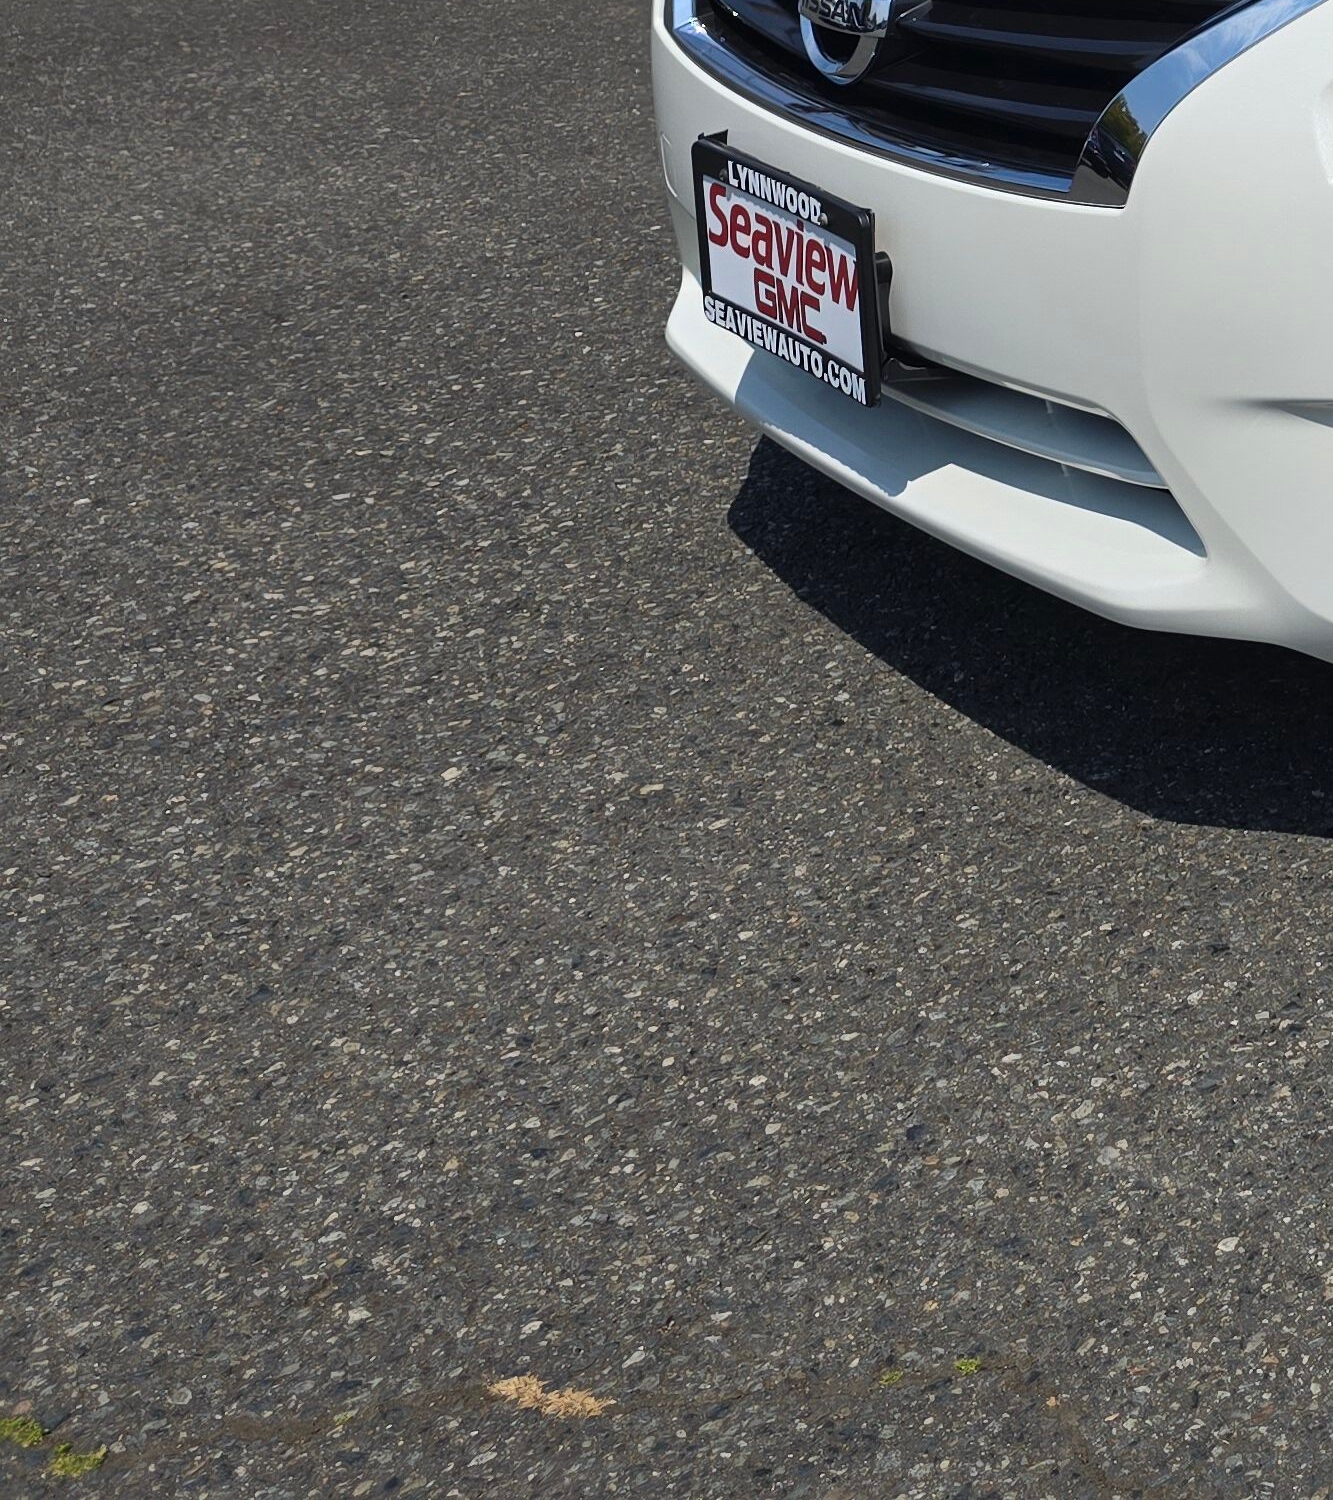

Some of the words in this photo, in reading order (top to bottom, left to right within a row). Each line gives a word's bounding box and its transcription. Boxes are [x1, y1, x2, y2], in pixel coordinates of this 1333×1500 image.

[727, 160, 823, 226] LYNNWOOD
[708, 182, 859, 312] Seaview
[704, 295, 868, 407] SEAVIEWAUTO.COM
[753, 267, 828, 346] GMC
